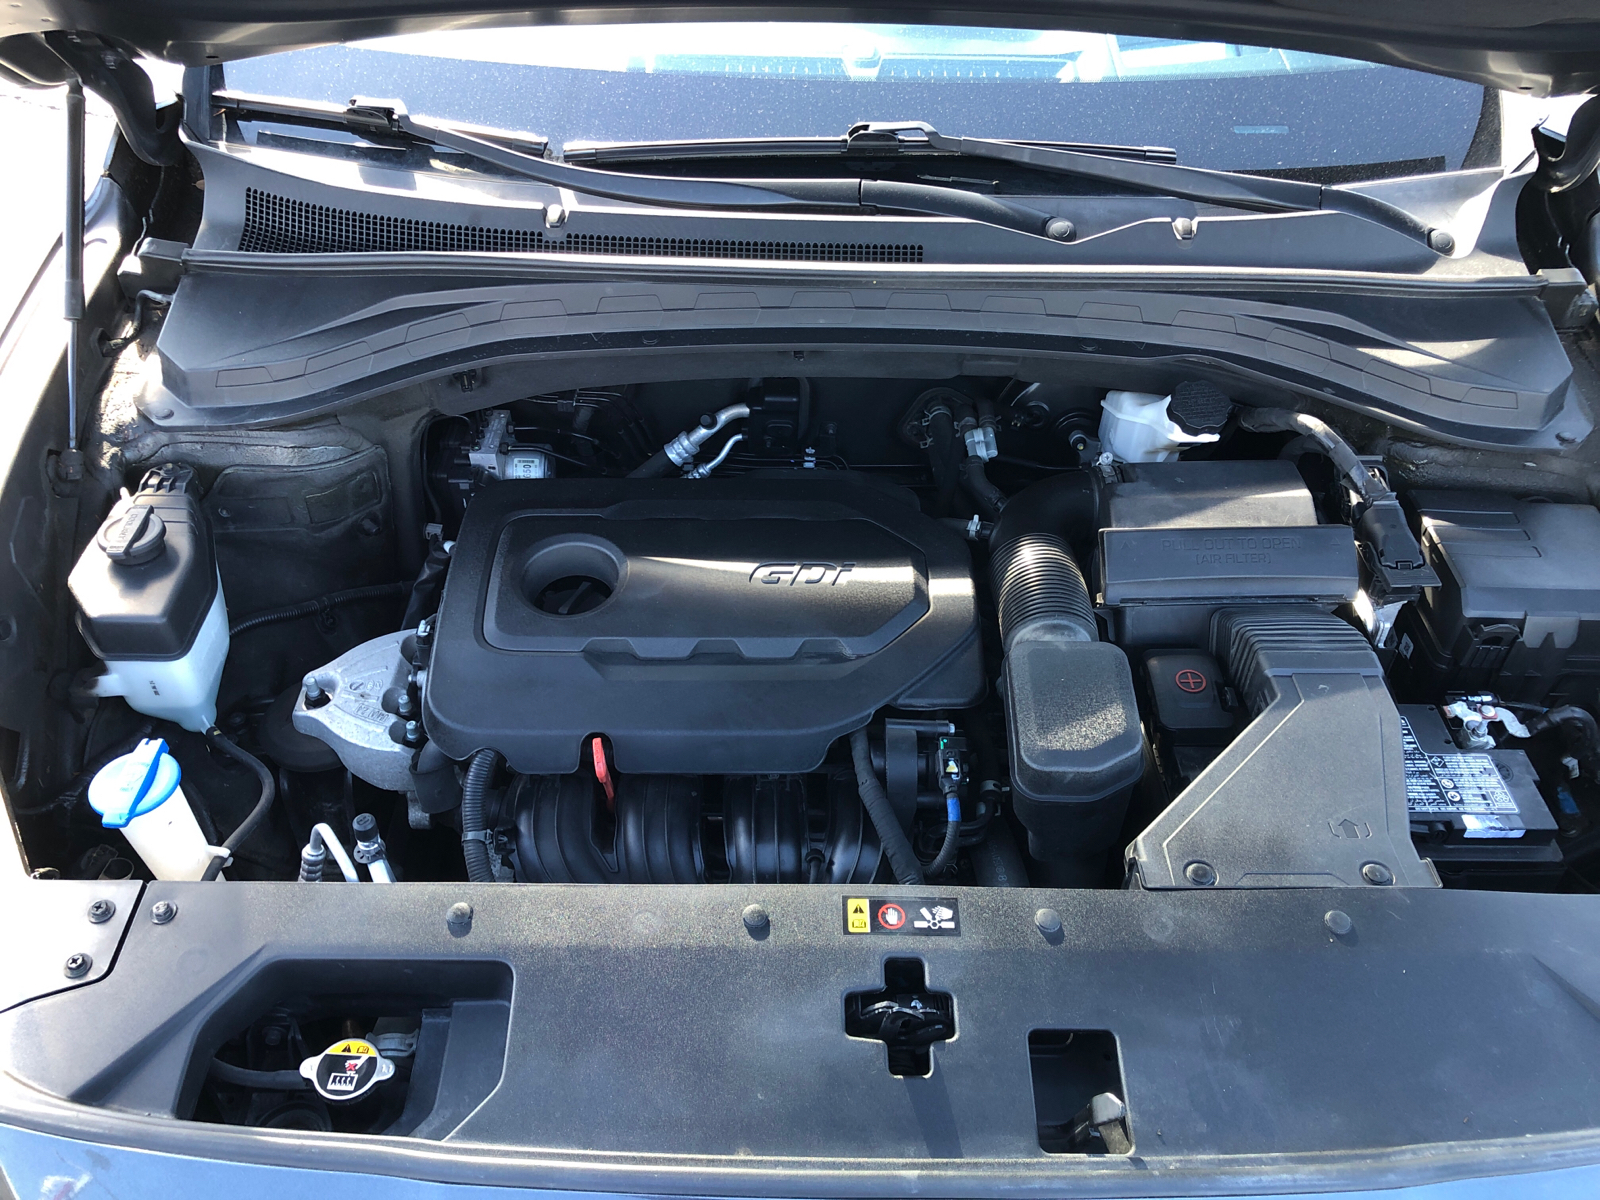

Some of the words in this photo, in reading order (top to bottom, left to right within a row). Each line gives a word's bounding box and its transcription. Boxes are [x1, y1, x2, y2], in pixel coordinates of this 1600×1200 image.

[1161, 538, 1200, 550] PULL
[1203, 538, 1234, 550] OUT
[1236, 538, 1257, 550] TO
[1262, 537, 1302, 549] OPEN
